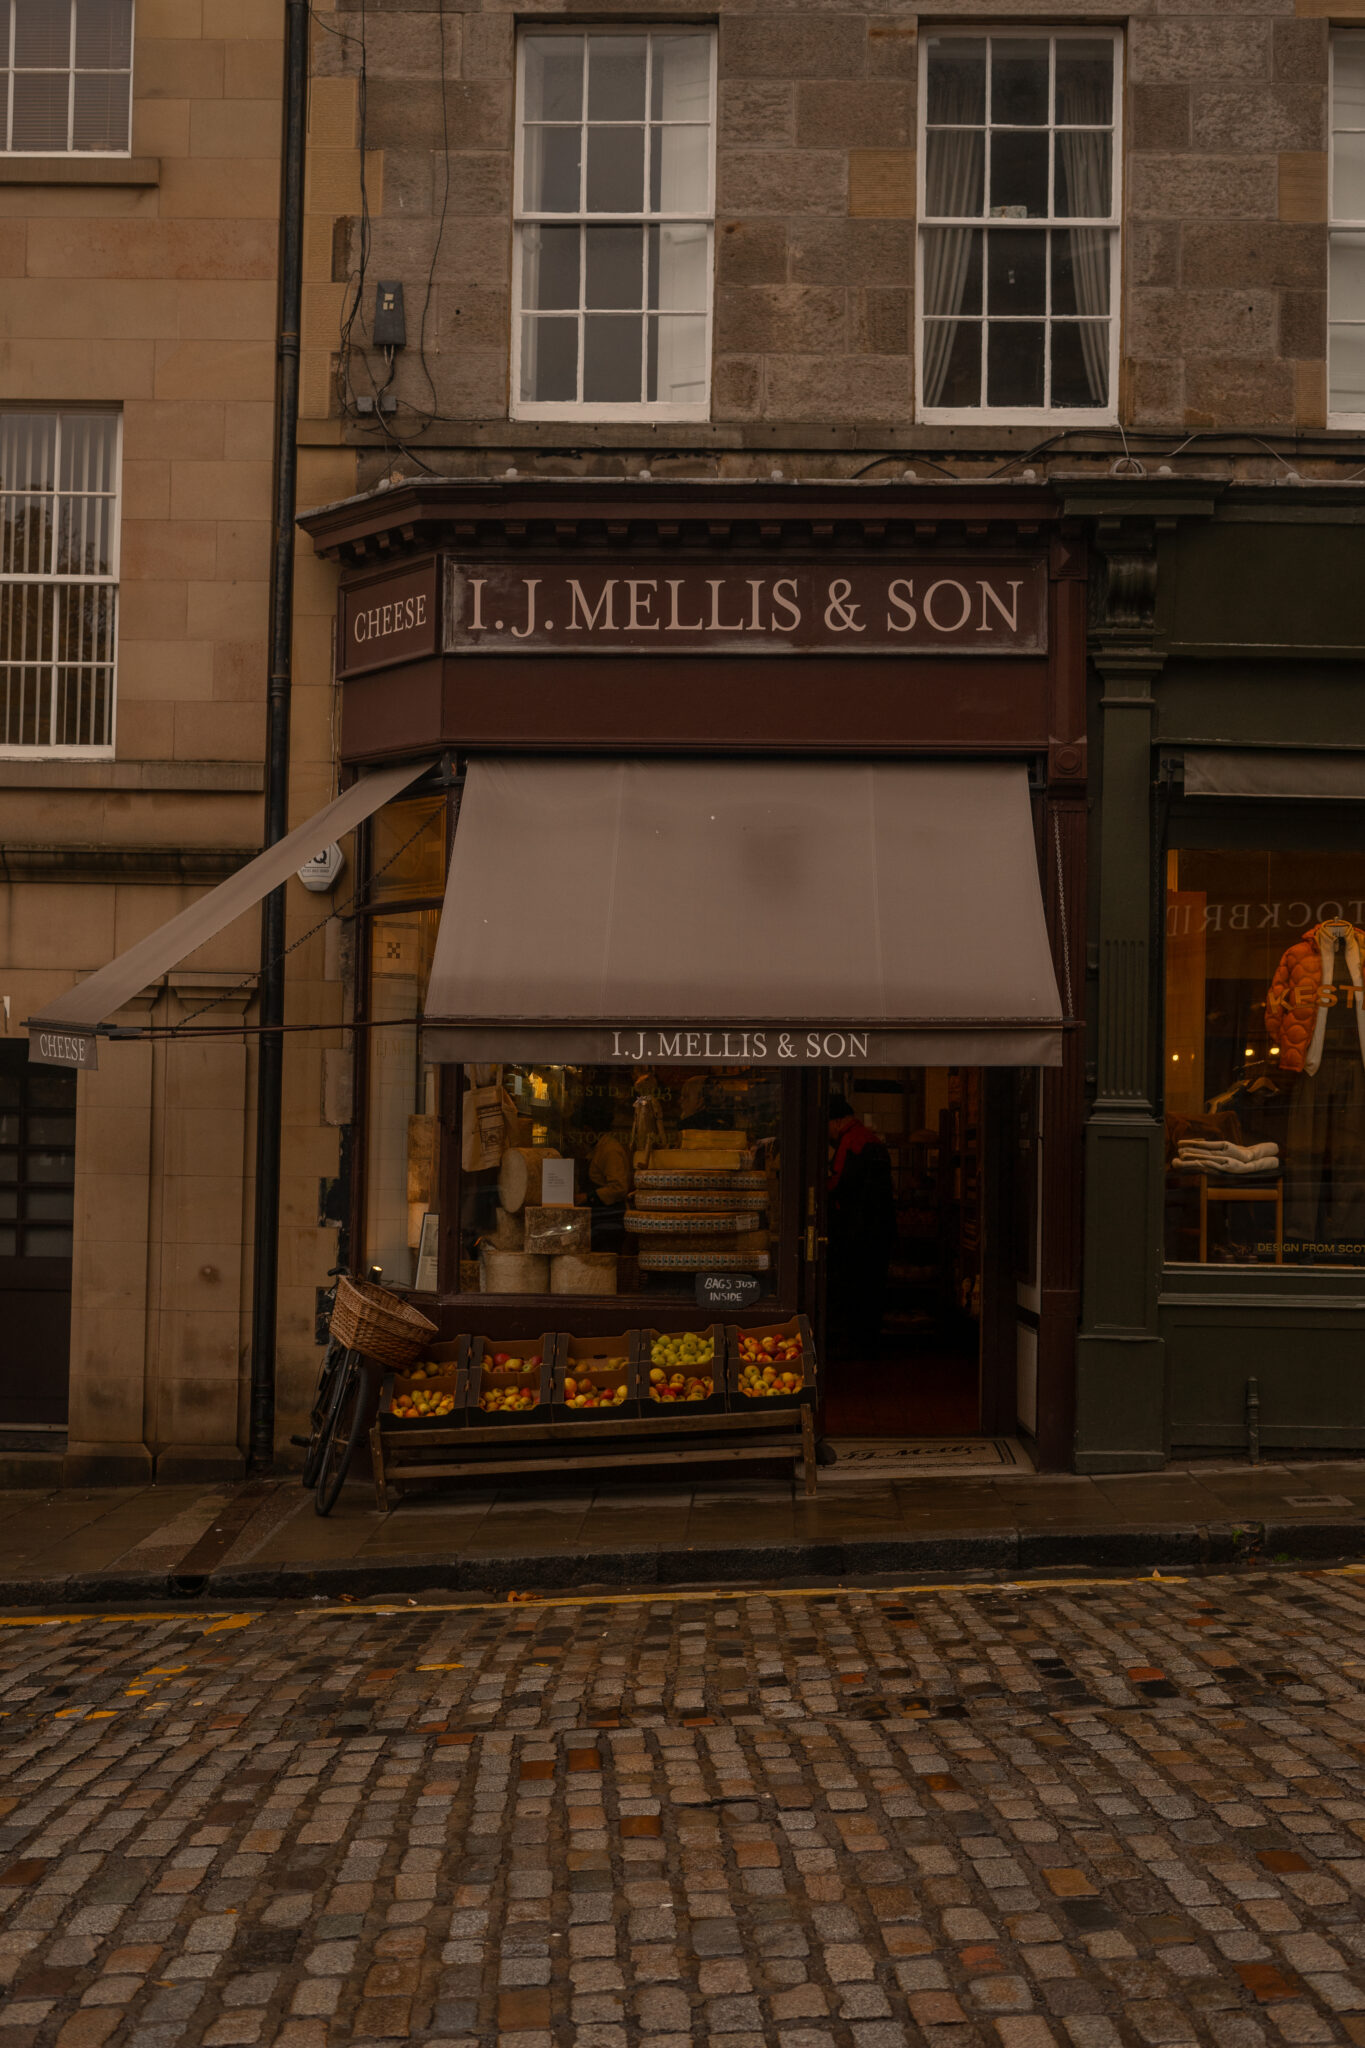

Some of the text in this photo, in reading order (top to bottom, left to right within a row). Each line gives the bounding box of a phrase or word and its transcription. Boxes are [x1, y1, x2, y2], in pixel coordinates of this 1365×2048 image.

[354, 594, 427, 643] CHEESE
[823, 579, 867, 633] &
[886, 578, 1024, 633] SON
[39, 1033, 85, 1061] CHEESE
[777, 1032, 798, 1058] &
[806, 1032, 870, 1059] SON
[1302, 1243, 1335, 1253] FROM
[704, 1277, 757, 1290] BAGS JUST
[709, 1292, 744, 1302] INSIDE
